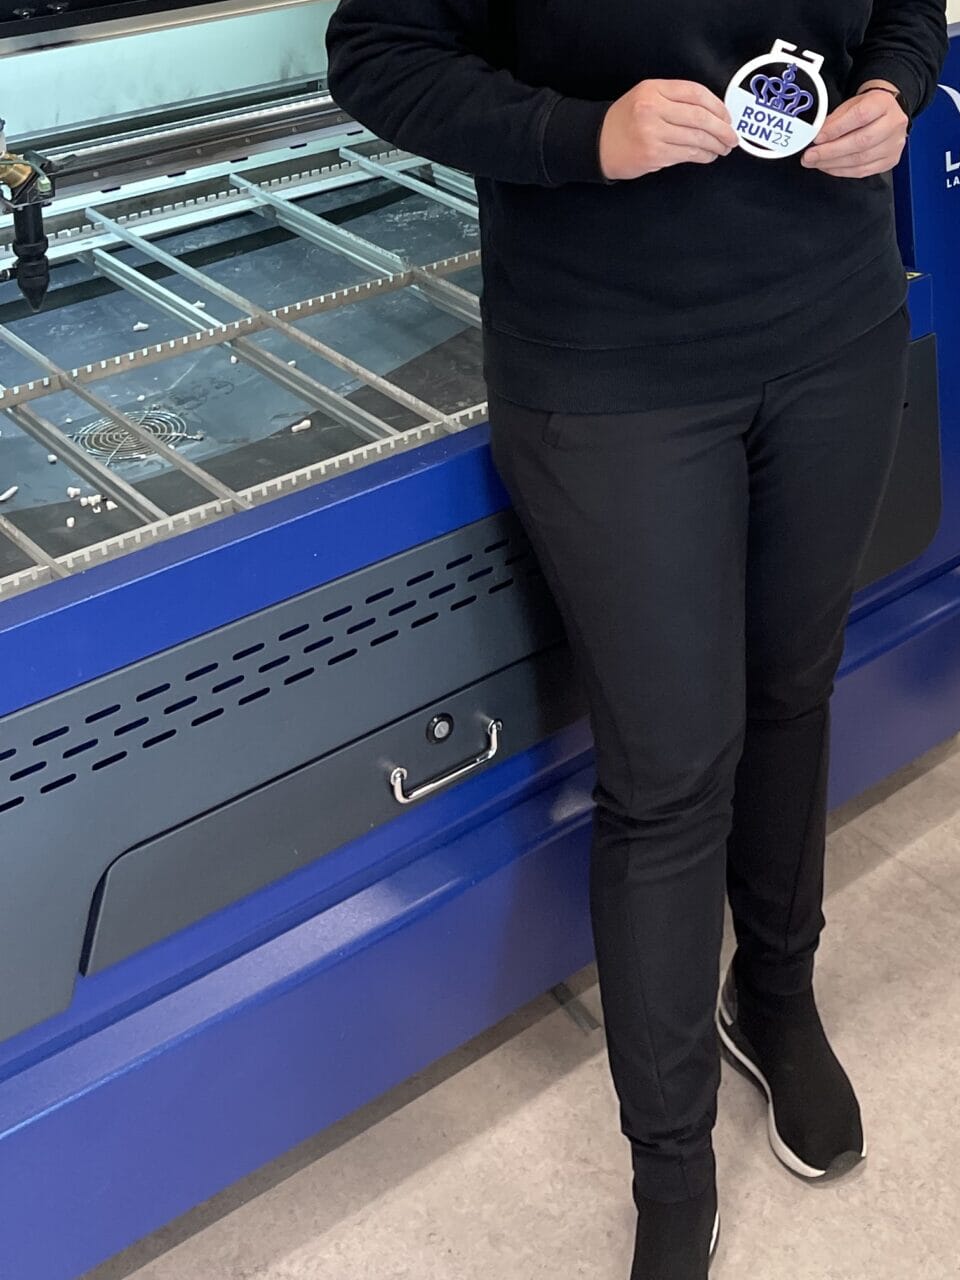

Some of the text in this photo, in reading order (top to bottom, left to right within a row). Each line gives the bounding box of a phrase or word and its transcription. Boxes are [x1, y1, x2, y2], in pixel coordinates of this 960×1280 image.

[737, 120, 791, 147] RUN 23
[742, 106, 793, 134] ROYAL
